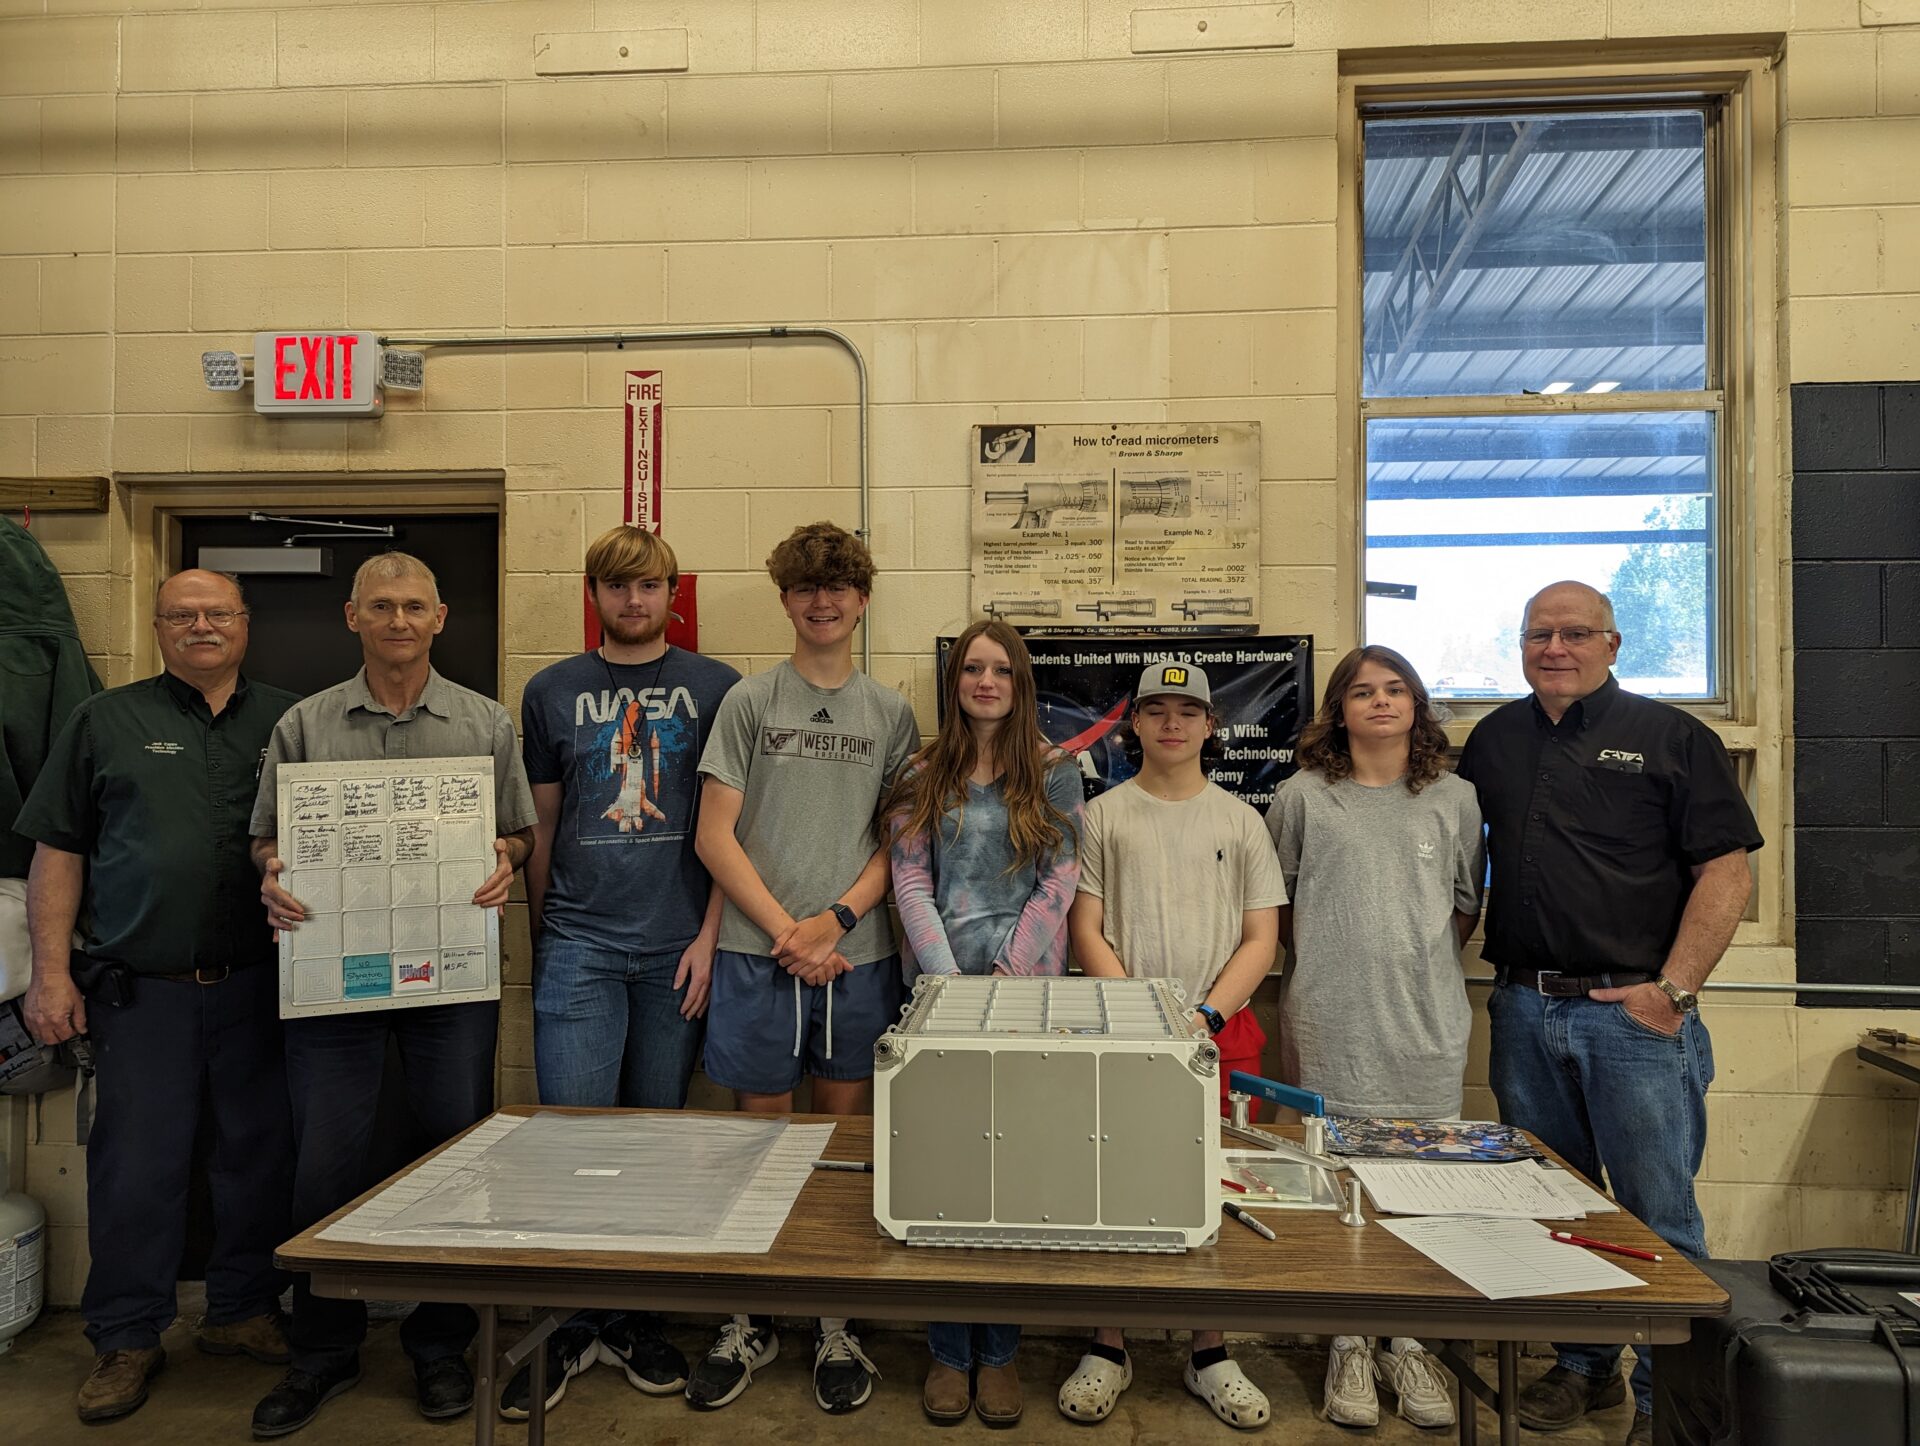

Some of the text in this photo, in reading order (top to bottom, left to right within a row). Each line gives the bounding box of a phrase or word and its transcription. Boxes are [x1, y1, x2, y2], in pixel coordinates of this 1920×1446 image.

[275, 336, 358, 400] EXIT
[627, 384, 661, 400] FIRE
[1073, 434, 1219, 446] How to read micrometers
[1022, 530, 1050, 539] Example
[1164, 529, 1192, 537] Example
[1029, 650, 1294, 665] tudents United With NASA To Create Hardware
[575, 686, 699, 726] NASA
[1233, 724, 1269, 738] With:
[804, 732, 873, 757] WEST POINT
[815, 752, 862, 762] BASEBALL
[1223, 746, 1294, 763] Technology
[1207, 768, 1244, 785] demy
[443, 962, 469, 971] MSFC
